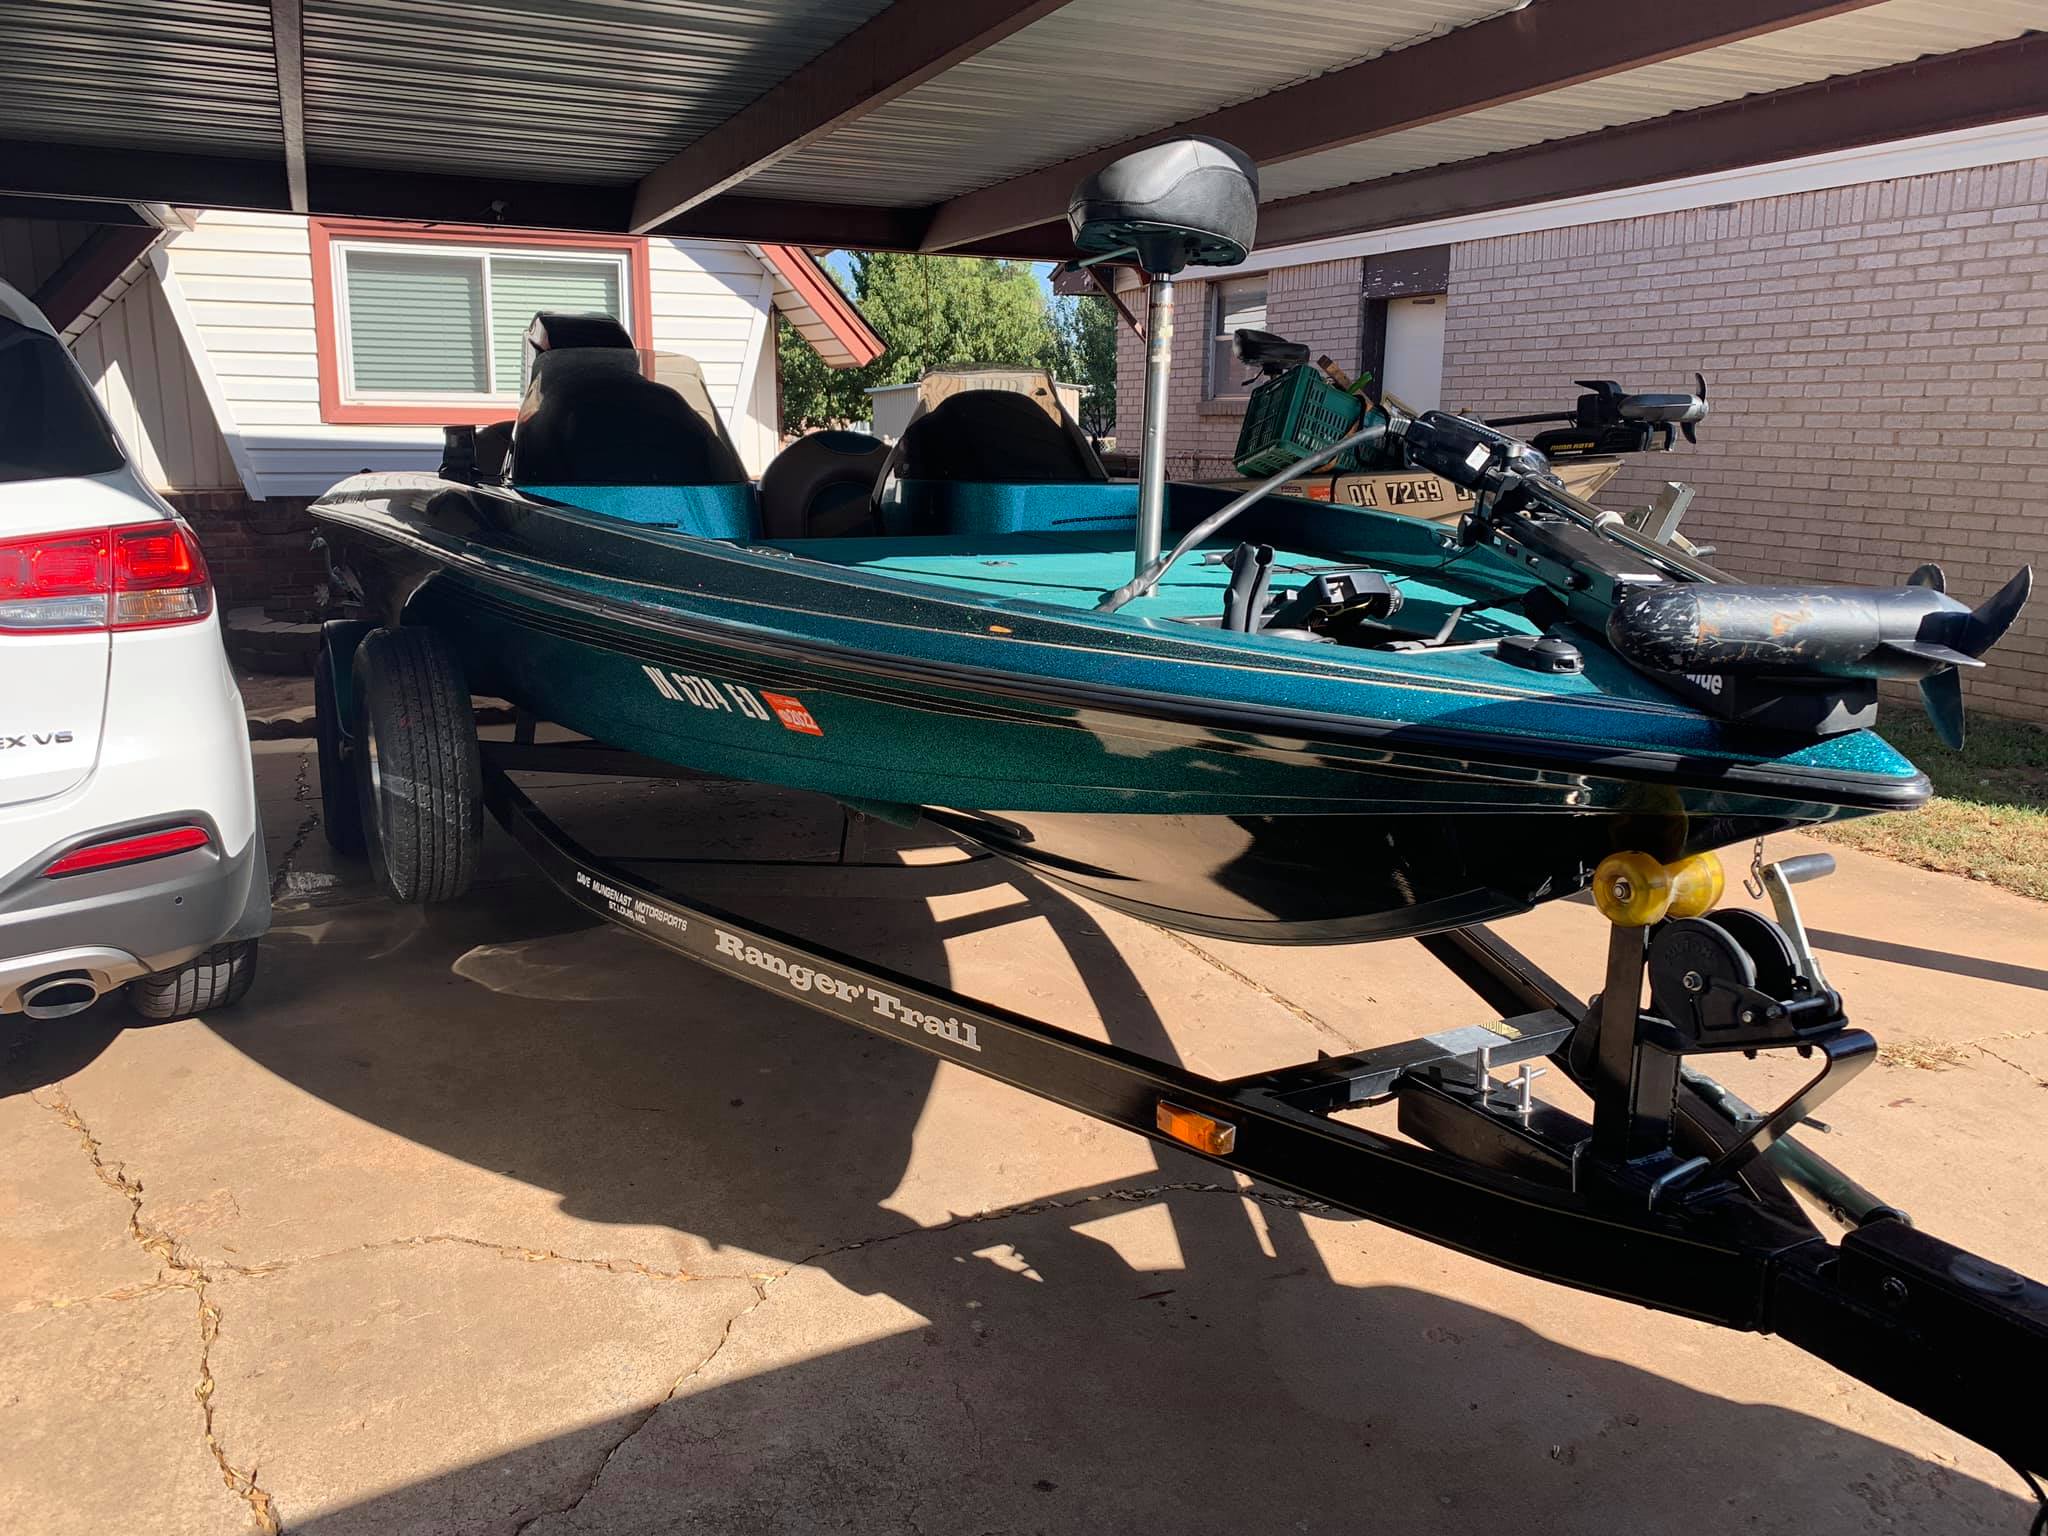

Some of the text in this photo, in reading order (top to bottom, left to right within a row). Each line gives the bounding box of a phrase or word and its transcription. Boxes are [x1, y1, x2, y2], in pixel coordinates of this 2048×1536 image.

[1348, 484, 1377, 507] OK
[1386, 480, 1443, 505] 7269
[642, 665, 684, 701] OK
[32, 731, 73, 745] V6
[576, 871, 591, 888] DAVE
[634, 900, 688, 931] MOTORSPORTS
